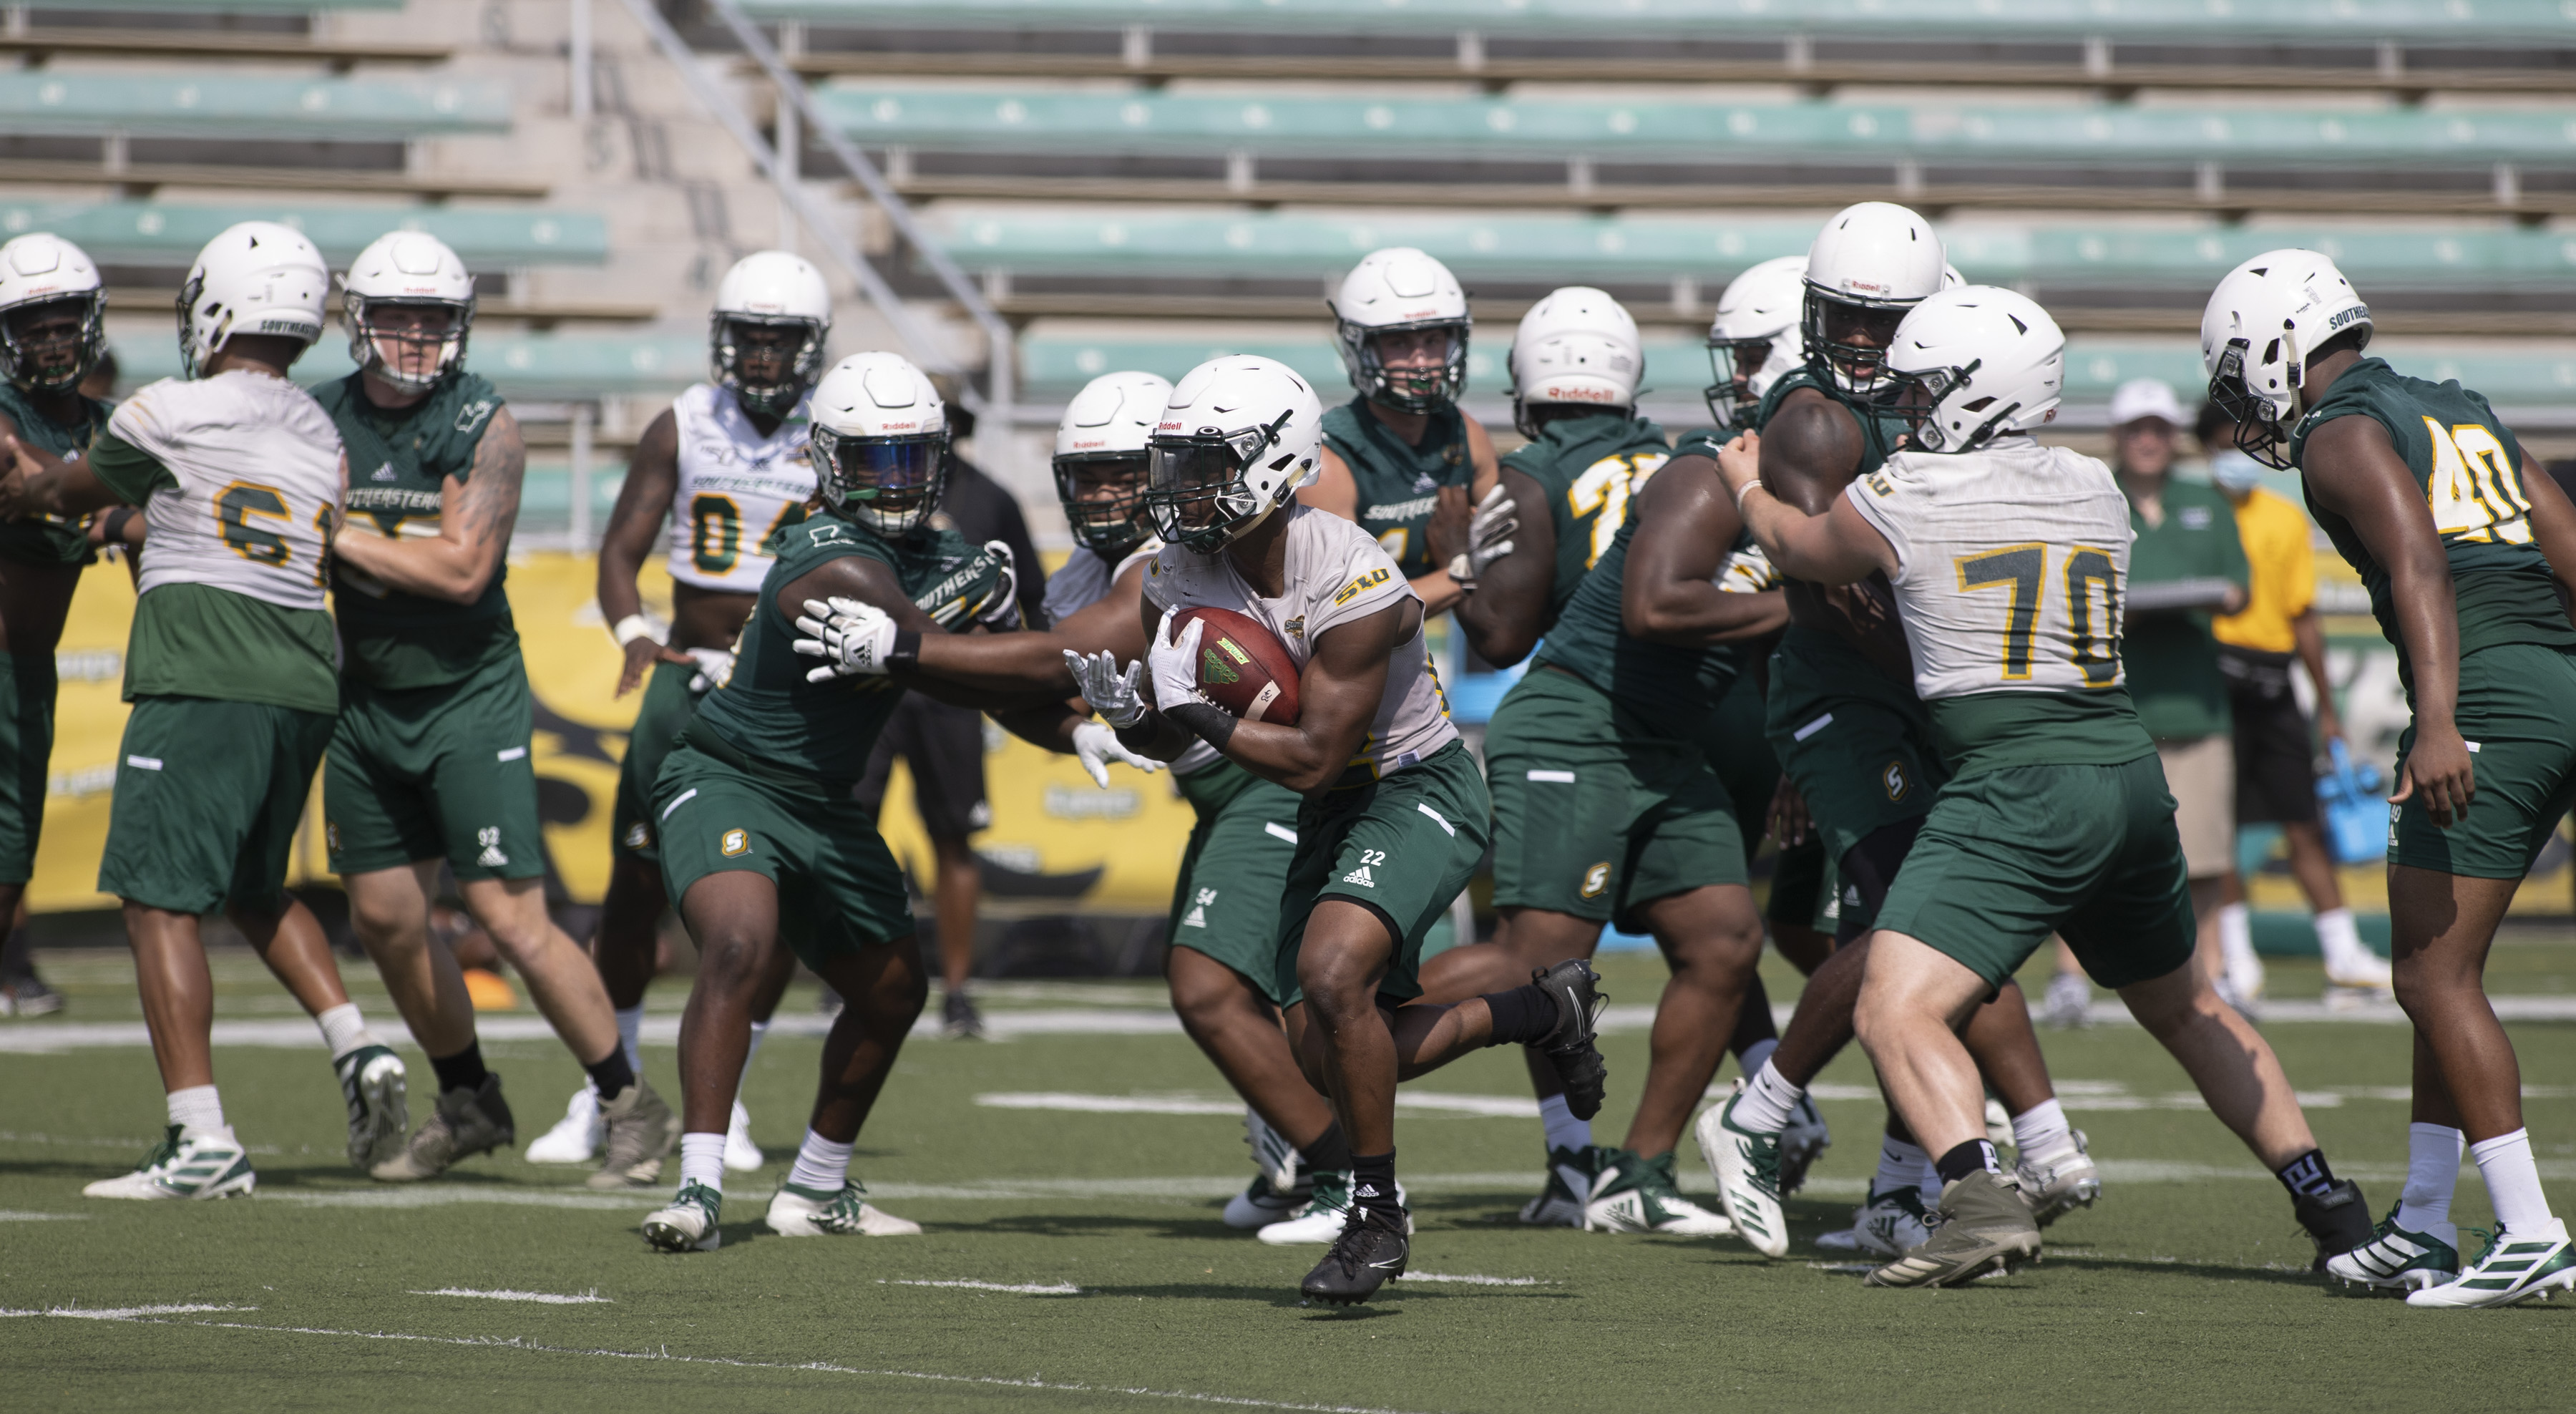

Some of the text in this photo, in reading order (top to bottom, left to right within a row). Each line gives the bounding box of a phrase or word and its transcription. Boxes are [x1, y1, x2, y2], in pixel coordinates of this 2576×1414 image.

[1851, 280, 1881, 292] Riddell
[1548, 387, 1615, 403] Riddell
[882, 421, 917, 431] Riddell
[1158, 421, 1182, 431] Riddell
[1073, 440, 1106, 449] Riddell
[2421, 414, 2534, 545] 40
[1953, 542, 2119, 688] 70
[864, 639, 873, 669] adidas
[1217, 637, 1249, 665] DIME
[1204, 648, 1239, 683] adidas
[1885, 763, 1906, 799] S
[478, 827, 500, 847] 92
[723, 829, 746, 854] S
[1360, 849, 1386, 867] 22
[1343, 875, 1375, 888] adidas
[1583, 863, 1609, 896] S
[1196, 887, 1218, 907] 54
